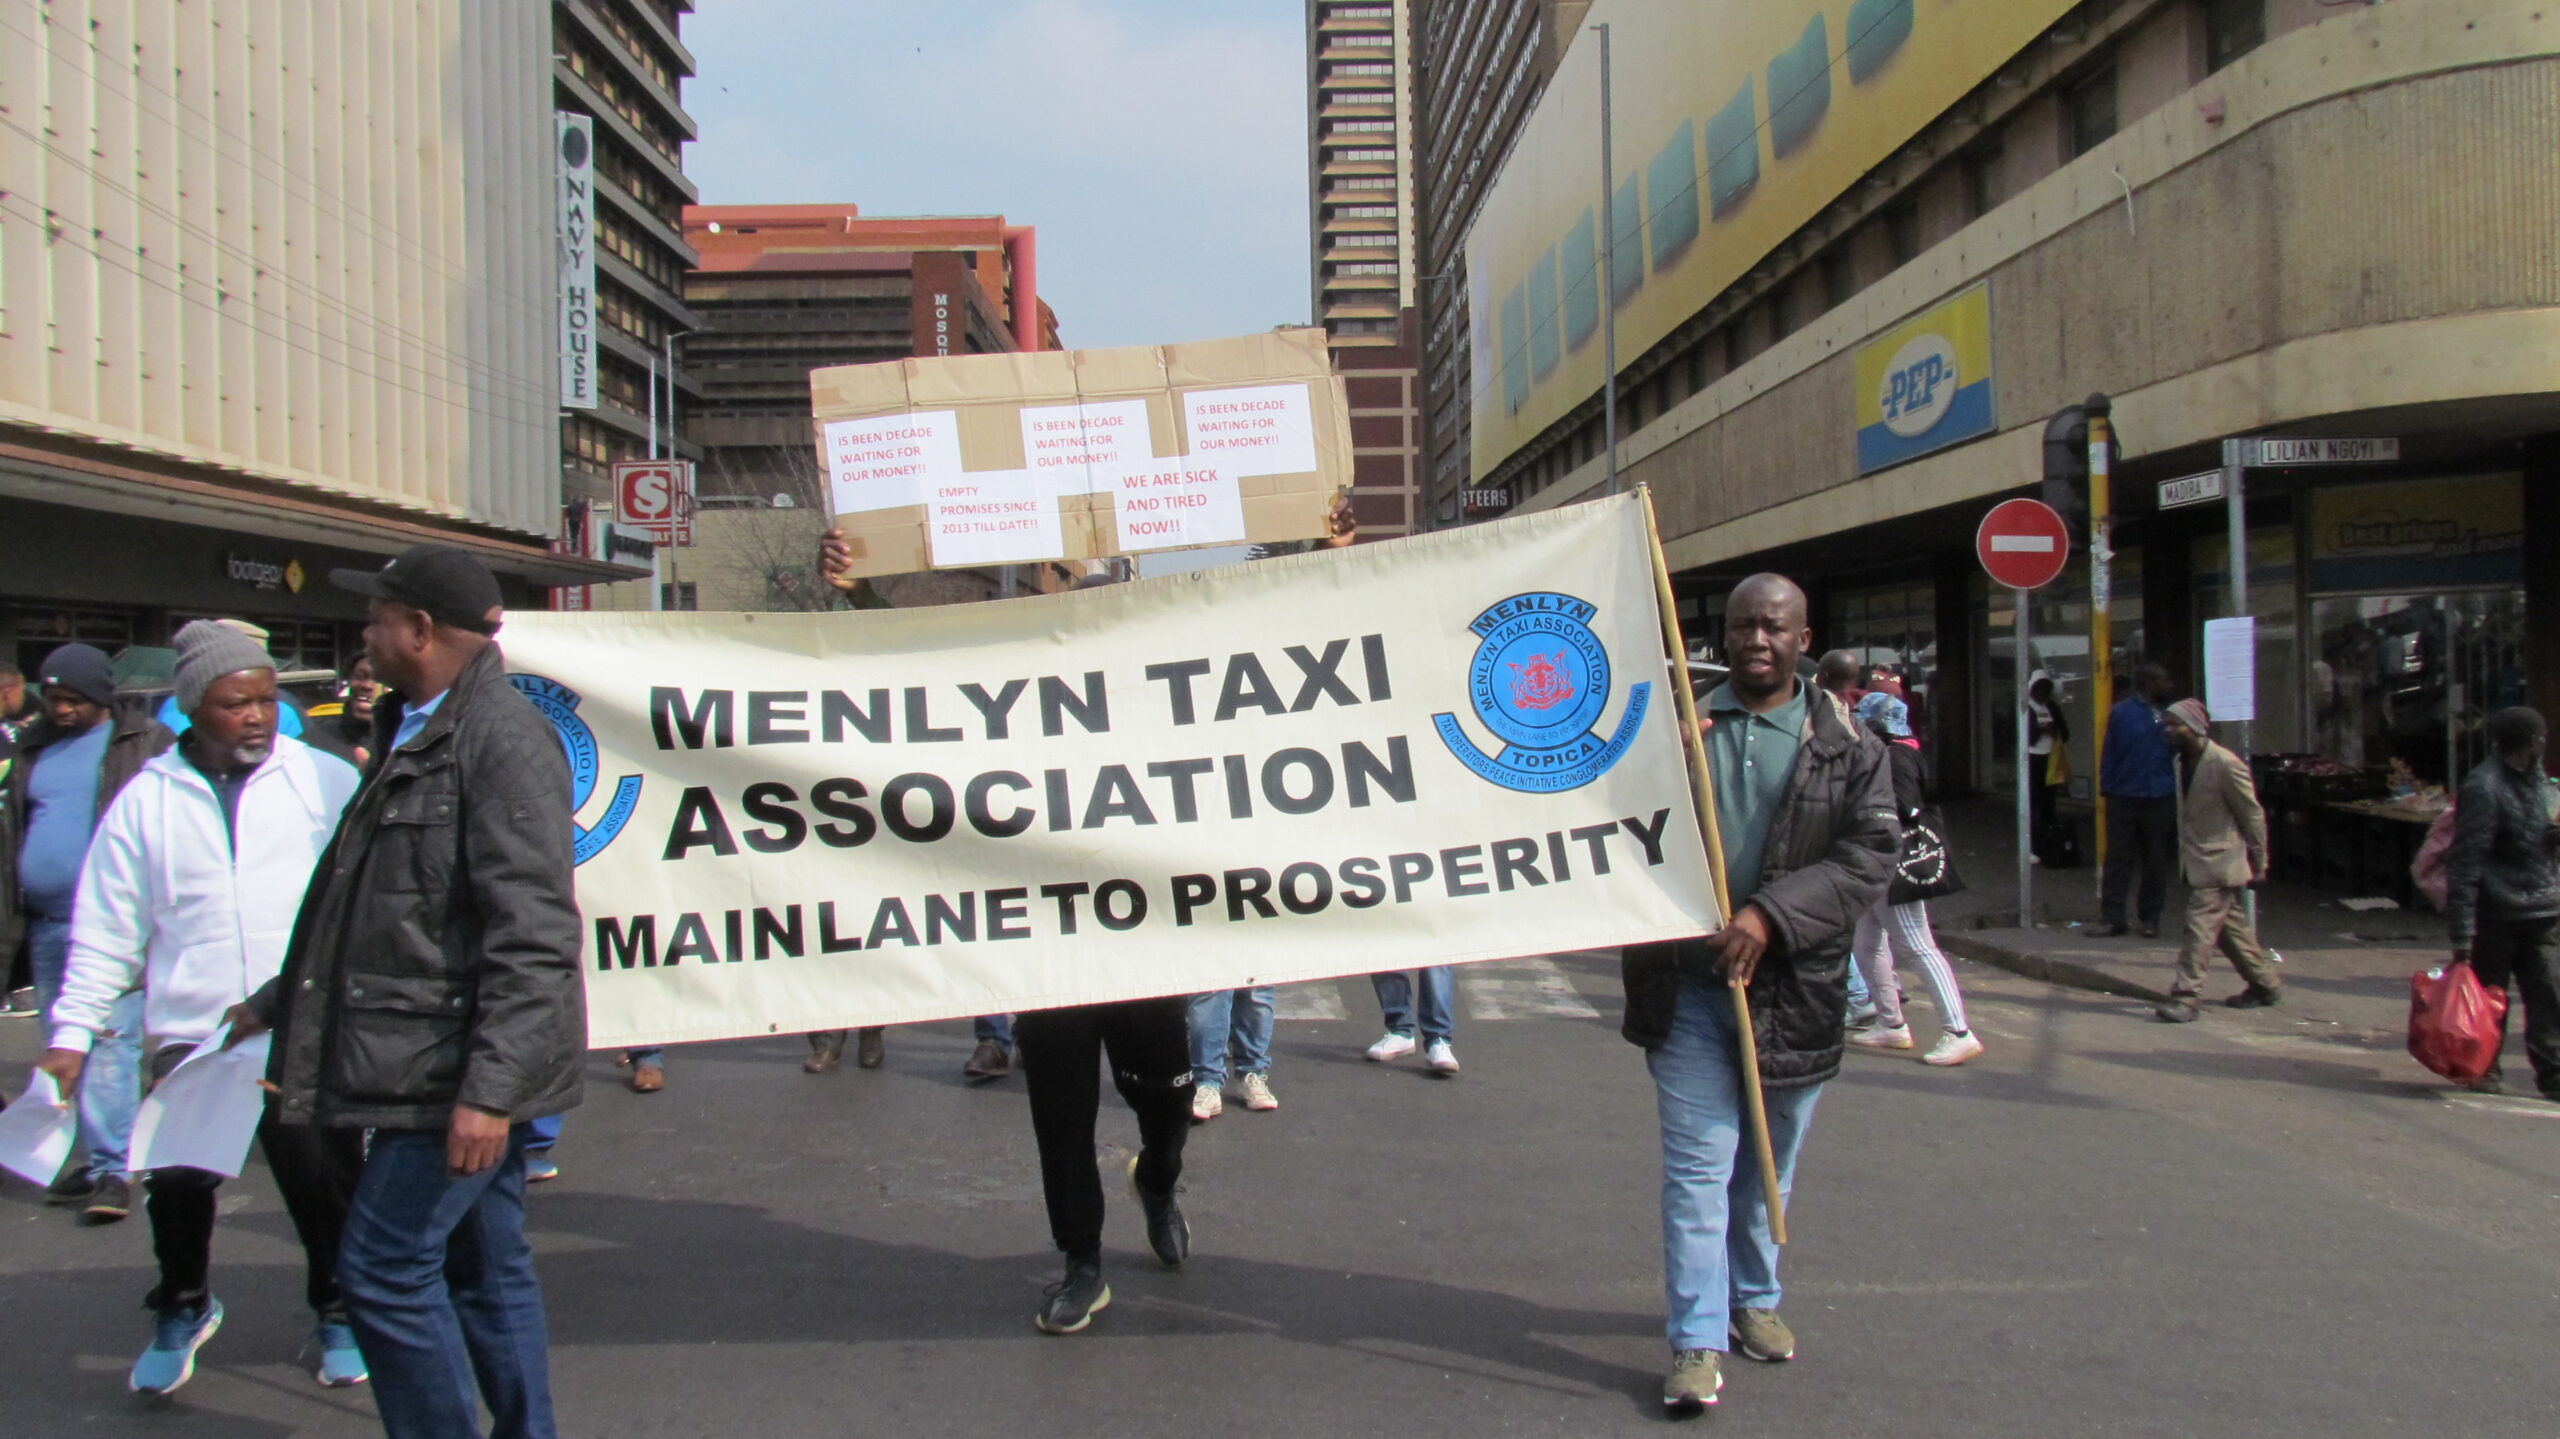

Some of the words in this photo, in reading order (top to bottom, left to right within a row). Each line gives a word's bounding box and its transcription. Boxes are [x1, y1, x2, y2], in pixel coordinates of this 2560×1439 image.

[567, 177, 586, 269] NAVY
[934, 293, 949, 357] MOSQU
[568, 286, 588, 398] HOUSE
[1886, 352, 1943, 420] PEP
[1196, 405, 1206, 416] IS
[1209, 403, 1238, 415] BEEN
[1241, 400, 1286, 412] DECADE
[1033, 421, 1043, 432] IS
[1047, 419, 1076, 431] BEEN
[1079, 415, 1124, 429] DECADE
[1198, 420, 1250, 433] WAITING
[1252, 417, 1275, 430] FOR
[838, 436, 849, 447] IS
[852, 432, 882, 445] BEEN
[886, 427, 933, 441] DECADE
[1035, 436, 1087, 449] WAITING
[1090, 434, 1113, 446] FOR
[1200, 438, 1226, 450] OUR
[1228, 435, 1279, 448] MONEY!!
[840, 449, 894, 465] WAITING
[897, 446, 922, 457] FOR
[1037, 455, 1063, 467] OUR
[1066, 452, 1118, 465] MONEY!!
[2268, 441, 2320, 461] LILIAN
[2327, 440, 2375, 460] NGOYI
[842, 470, 869, 483] OUR
[872, 464, 927, 479] MONEY!!
[1123, 475, 1148, 489] WE
[1152, 472, 1181, 486] ARE
[1185, 469, 1218, 484] SICK
[939, 486, 979, 498] EMPTY
[2165, 480, 2202, 503] MADIBA
[940, 503, 1000, 516] PROMISES
[1004, 501, 1038, 513] SINCE
[1126, 498, 1160, 513] AND
[1164, 494, 1207, 509] TIRED
[942, 523, 970, 534] 2013
[974, 521, 997, 532] TILL
[999, 519, 1039, 531] DATE!!
[1129, 520, 1180, 536] NOW!!
[228, 552, 284, 588] footgear
[1475, 597, 1592, 633] MENLYN
[1477, 642, 1499, 712] MENLYN
[1496, 619, 1529, 643] TAXI
[1533, 617, 1604, 695] ASSOCIATION
[650, 670, 1111, 751] MENLYN
[1145, 633, 1393, 726] TAXI
[1441, 718, 1454, 737] TAXI
[1450, 734, 1490, 773] OPERATORS
[1489, 765, 1516, 785] PEACE
[1517, 776, 1559, 789] INITIATIVE
[1513, 742, 1594, 768] TOPICA
[662, 735, 1418, 860] ASSOCIATION
[602, 783, 636, 834] ASSOCIATION
[1170, 807, 1672, 927] PROSPERITY
